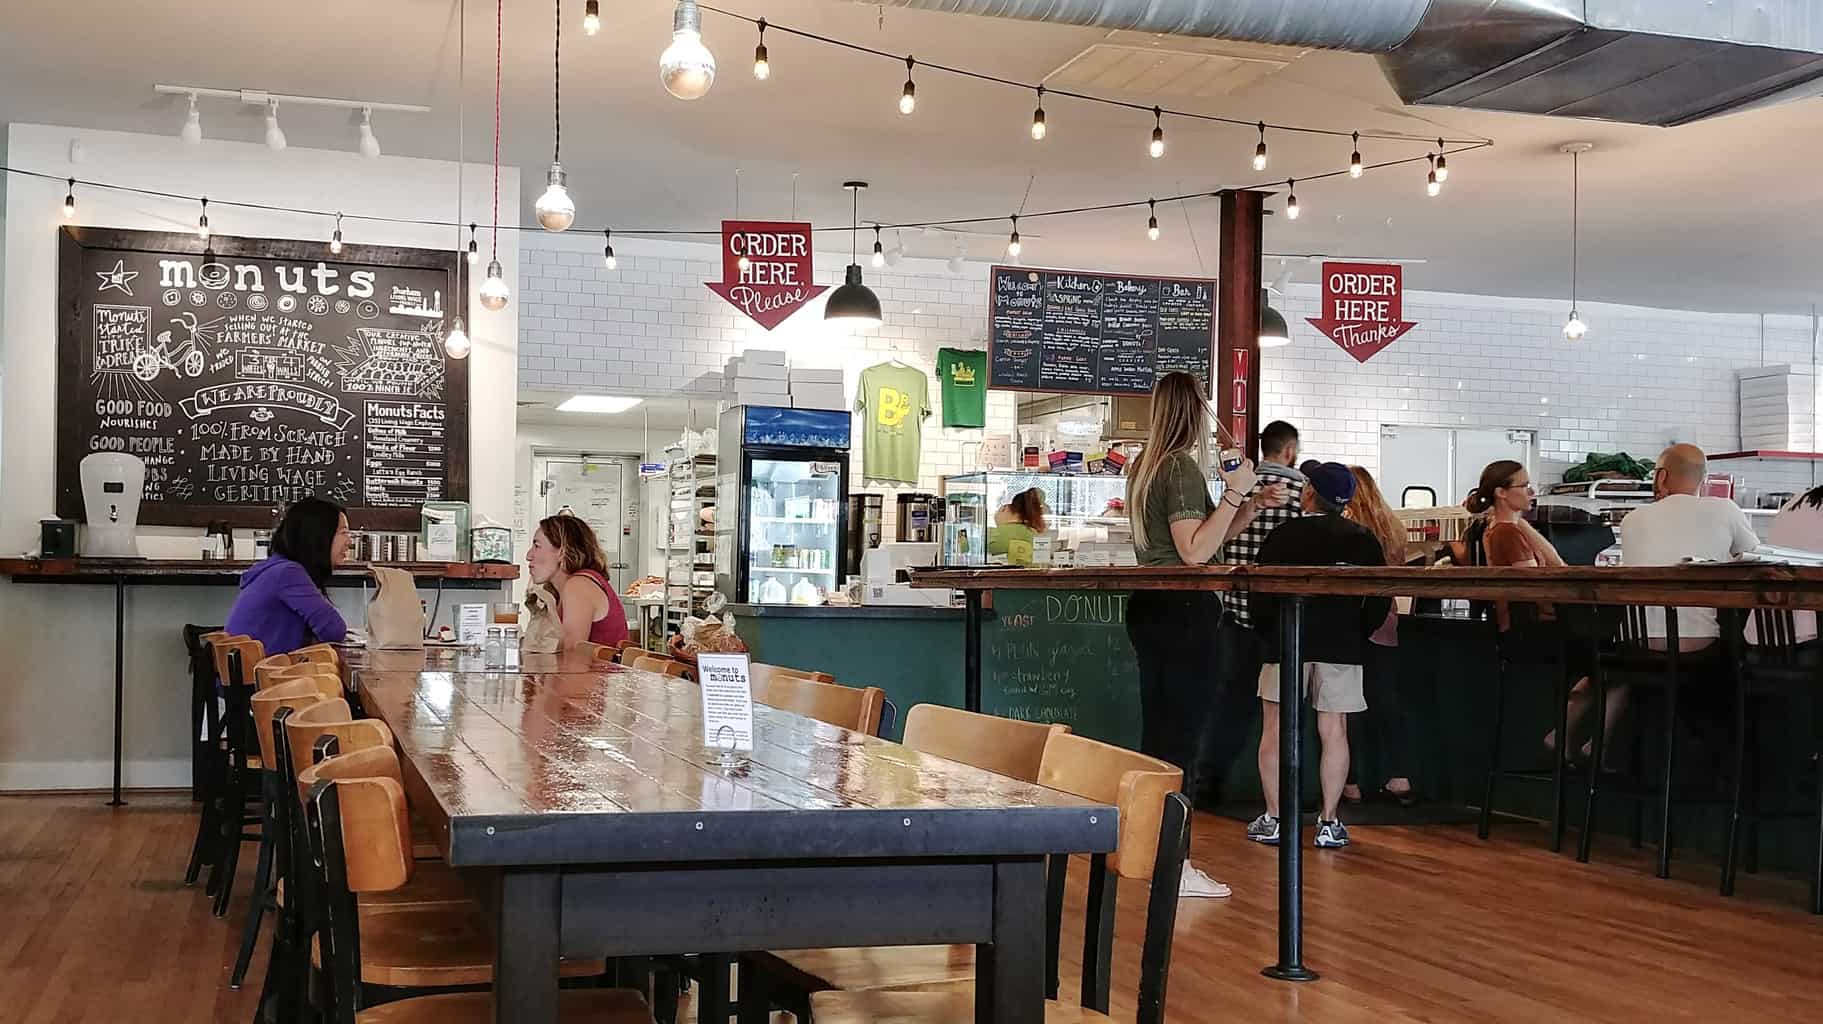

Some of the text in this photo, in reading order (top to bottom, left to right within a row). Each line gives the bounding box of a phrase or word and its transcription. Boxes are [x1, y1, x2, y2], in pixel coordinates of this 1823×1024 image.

[730, 232, 808, 257] ORDER
[1057, 275, 1092, 291] Kitchen
[1329, 273, 1397, 296] ORDER
[730, 286, 809, 316] Please
[99, 307, 148, 323] Monuts
[97, 322, 145, 336] started
[1333, 323, 1400, 348] Thanks
[98, 336, 145, 354] TRIKE
[277, 336, 327, 354] MARKET
[95, 398, 173, 418] GOOD FOOD
[200, 384, 337, 416] WE ARE PROUDLY
[367, 402, 445, 420] Monuts Facts
[99, 415, 158, 431] NOURISHES
[89, 434, 175, 454] GOOD PEOPLE
[190, 421, 349, 448] 100% FROM SCRATCH
[144, 455, 176, 466] HANGE
[200, 443, 336, 465] MADE BY HAND
[207, 463, 327, 489] LIVING WAGE
[1046, 594, 1128, 624] DONUT
[702, 664, 740, 674] Welcome to
